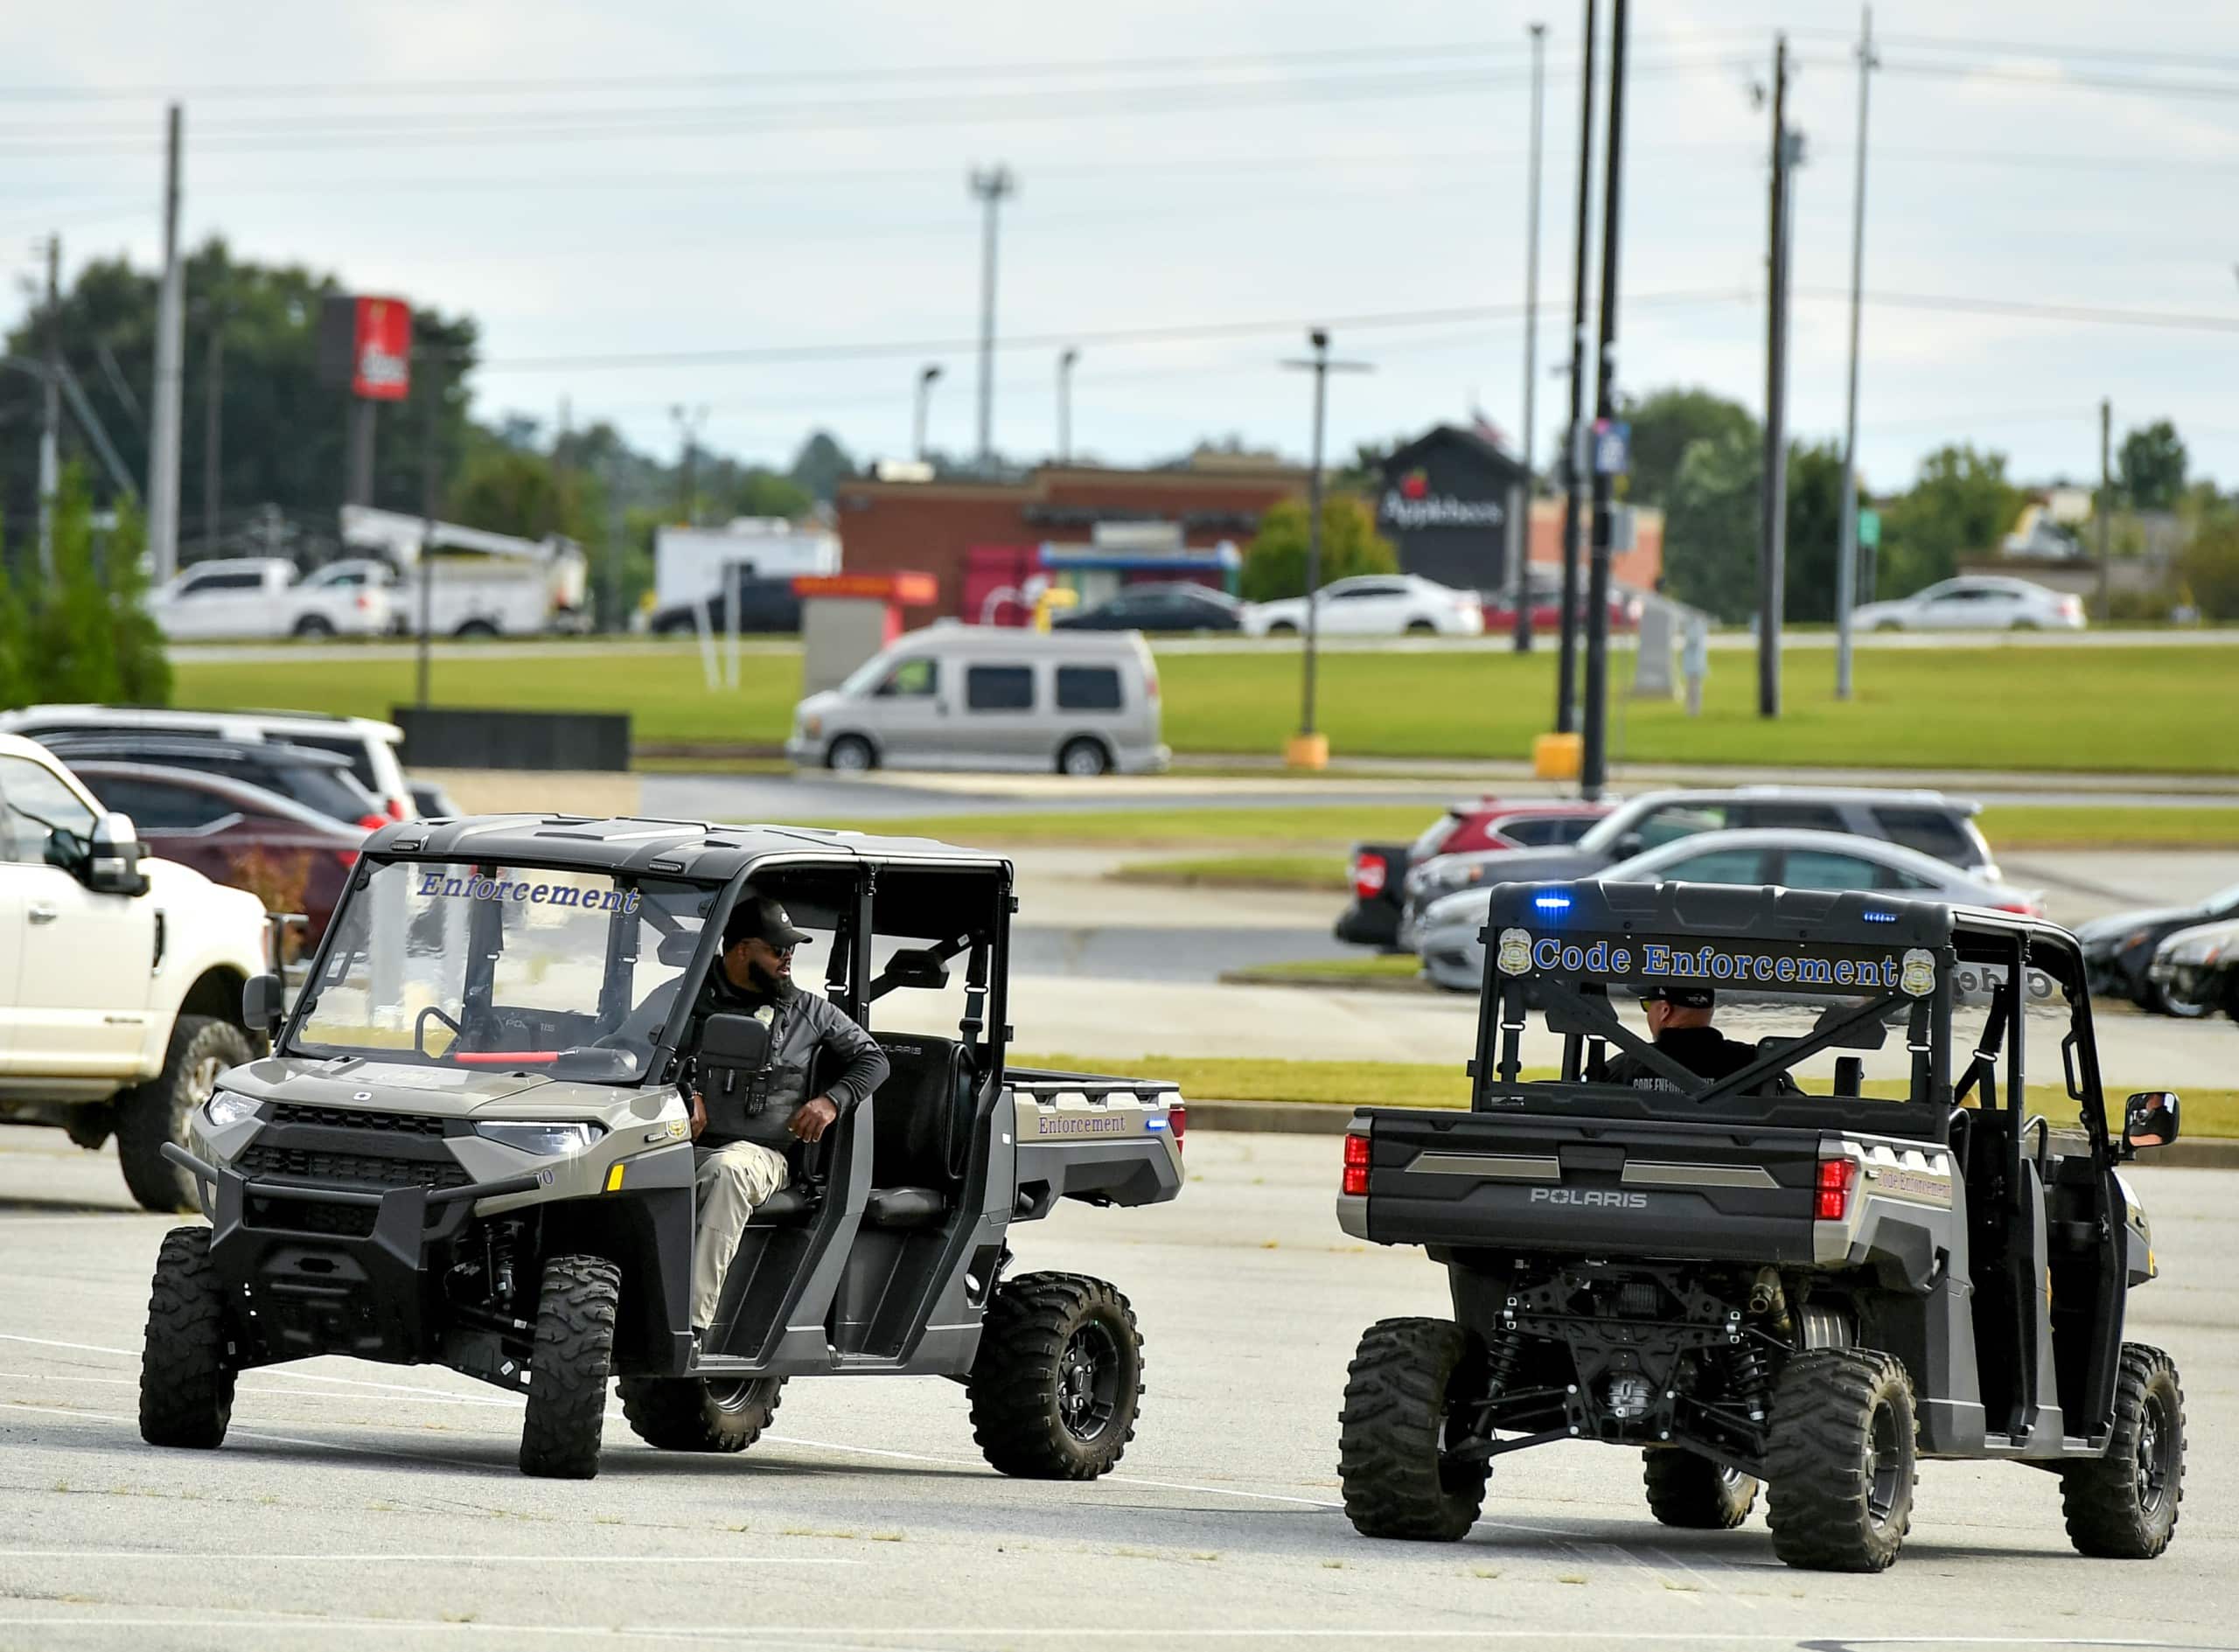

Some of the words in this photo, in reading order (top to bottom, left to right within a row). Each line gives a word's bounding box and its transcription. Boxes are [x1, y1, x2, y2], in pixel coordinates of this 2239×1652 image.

[417, 872, 640, 914] Enforcement
[1532, 938, 1631, 973] Code
[1642, 944, 1899, 987] Enforcement
[879, 1043, 922, 1055] OLARIS
[1038, 1115, 1126, 1135] Enforcement
[1900, 1172, 1951, 1199] Enforcemen
[1531, 1188, 1647, 1209] POLARIS
